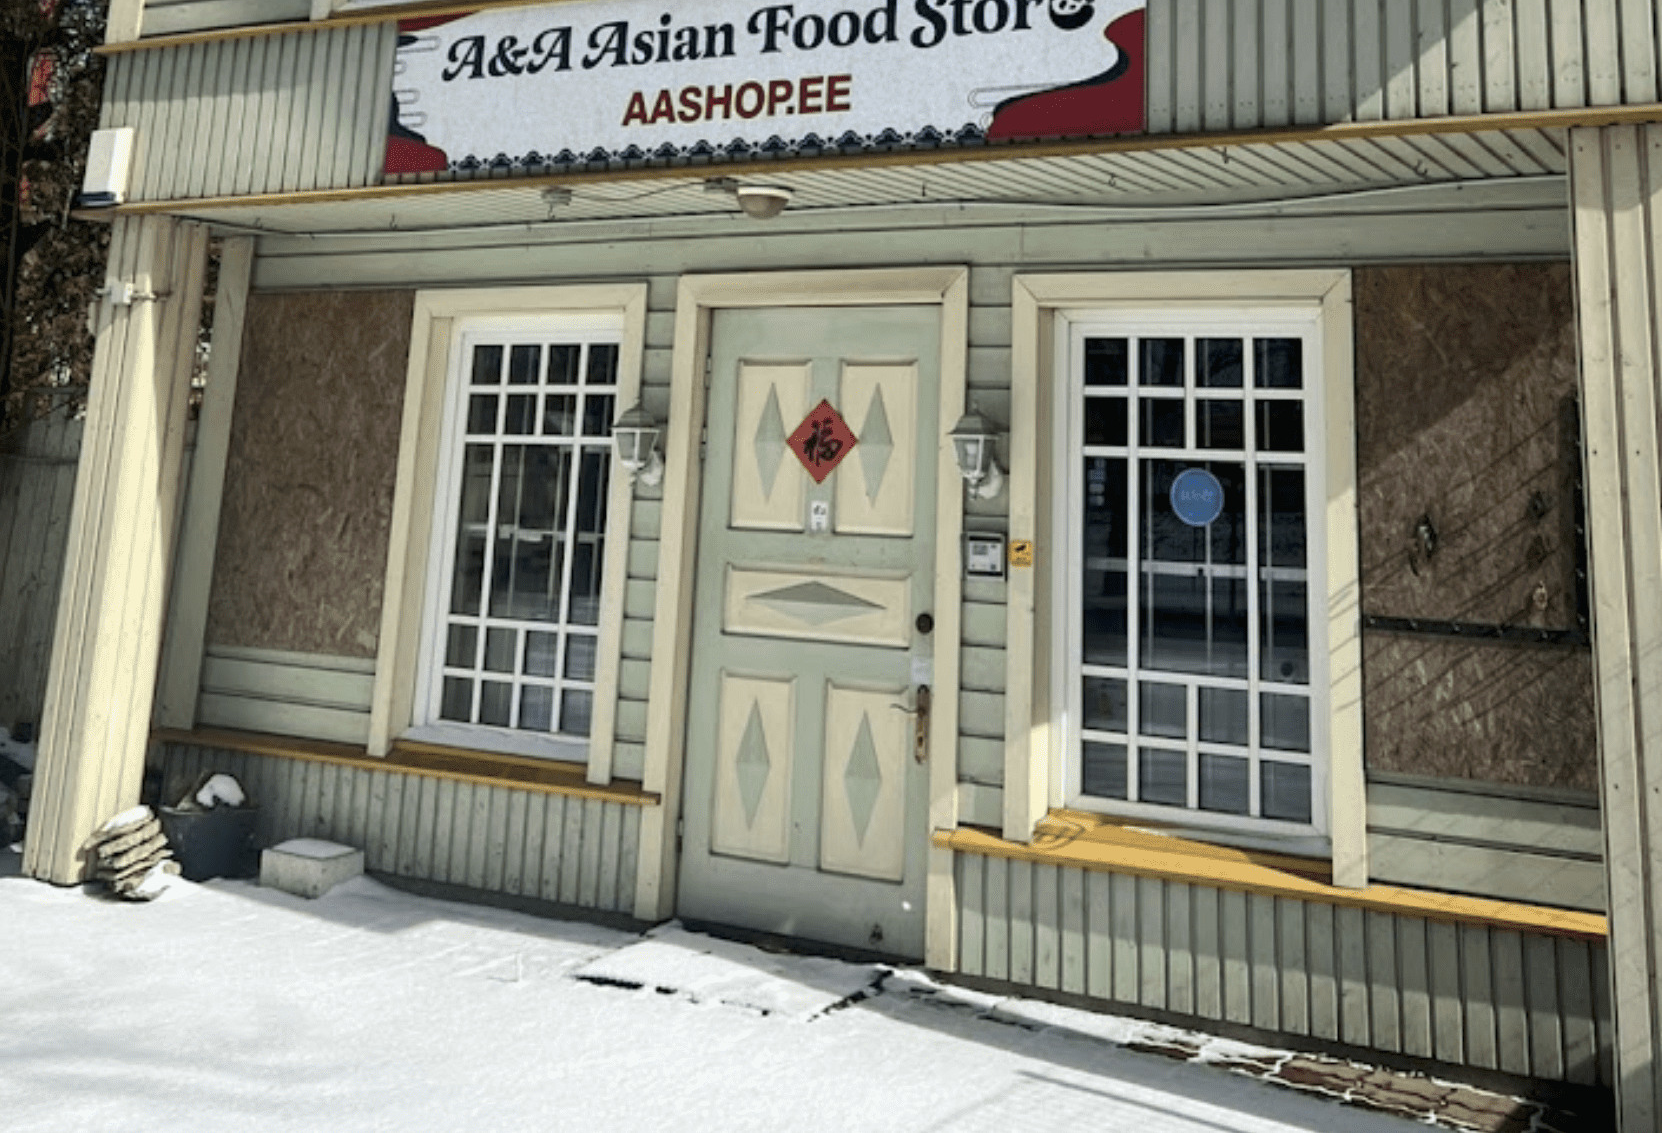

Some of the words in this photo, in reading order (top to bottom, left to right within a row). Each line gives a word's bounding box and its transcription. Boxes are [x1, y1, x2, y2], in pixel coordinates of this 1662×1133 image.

[441, 26, 573, 81] A&A
[581, 13, 736, 69] Asian
[622, 74, 853, 126] AASHOP.EE
[803, 417, 844, 468] 福
